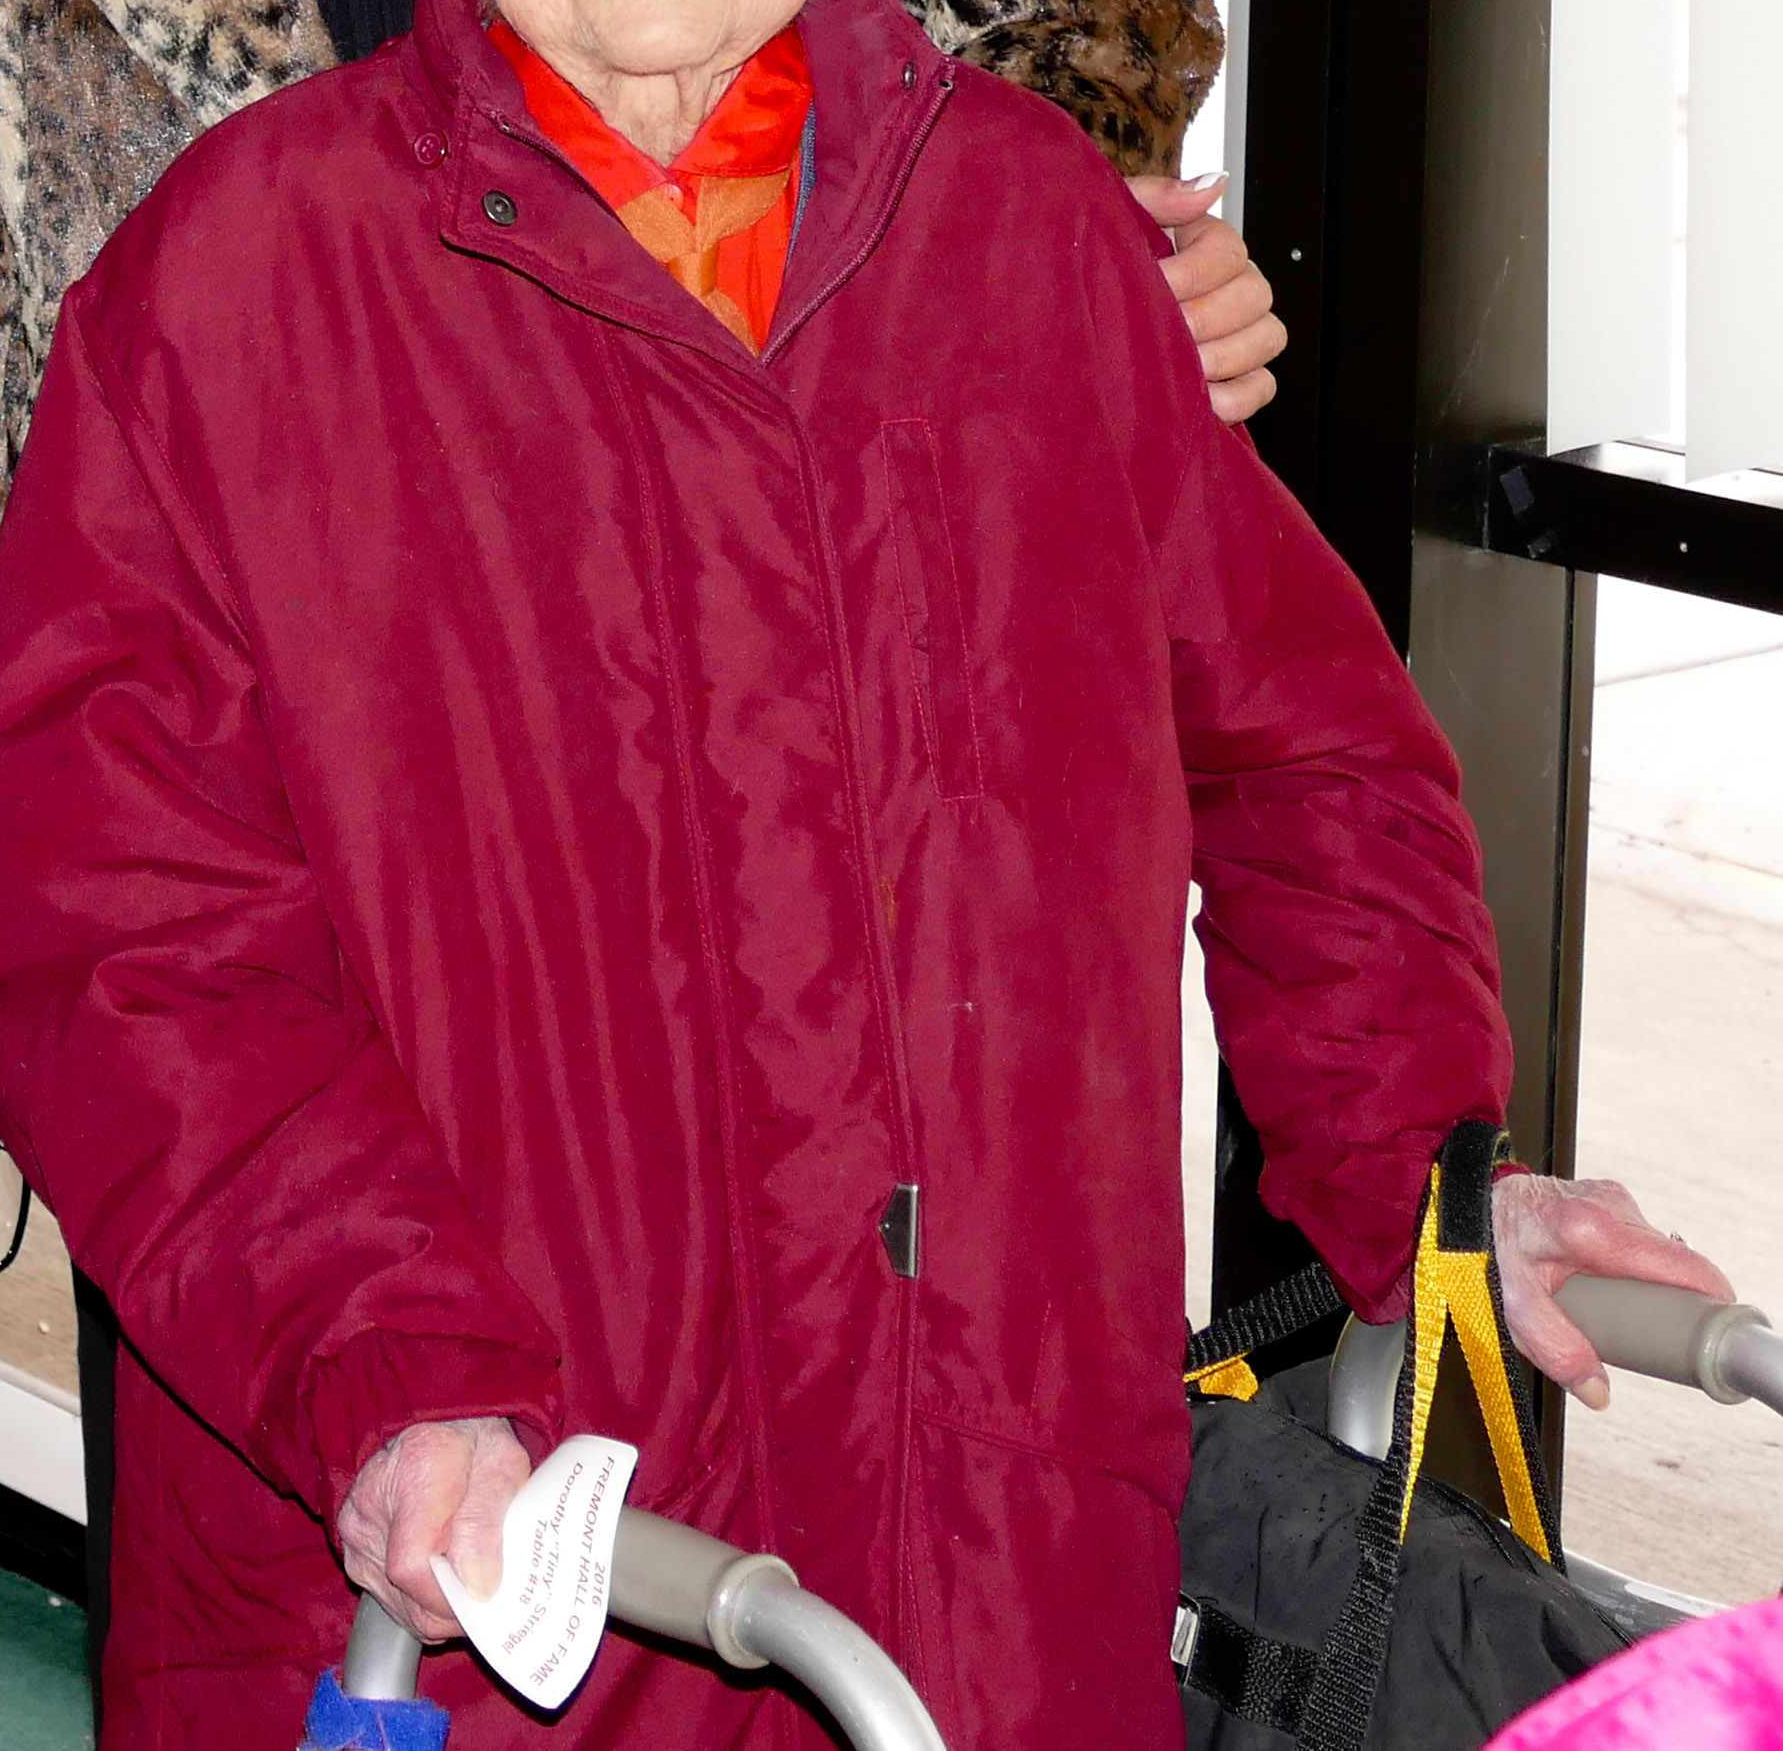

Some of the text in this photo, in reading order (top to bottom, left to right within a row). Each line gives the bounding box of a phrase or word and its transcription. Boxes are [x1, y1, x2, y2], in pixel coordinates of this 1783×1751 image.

[549, 1462, 584, 1534] Dorothy
[519, 1518, 547, 1606] Table #18
[529, 1456, 615, 1685] FREMONT HALL OF FAME
[591, 1563, 605, 1607] 2016
[502, 1603, 546, 1655] Striegel
